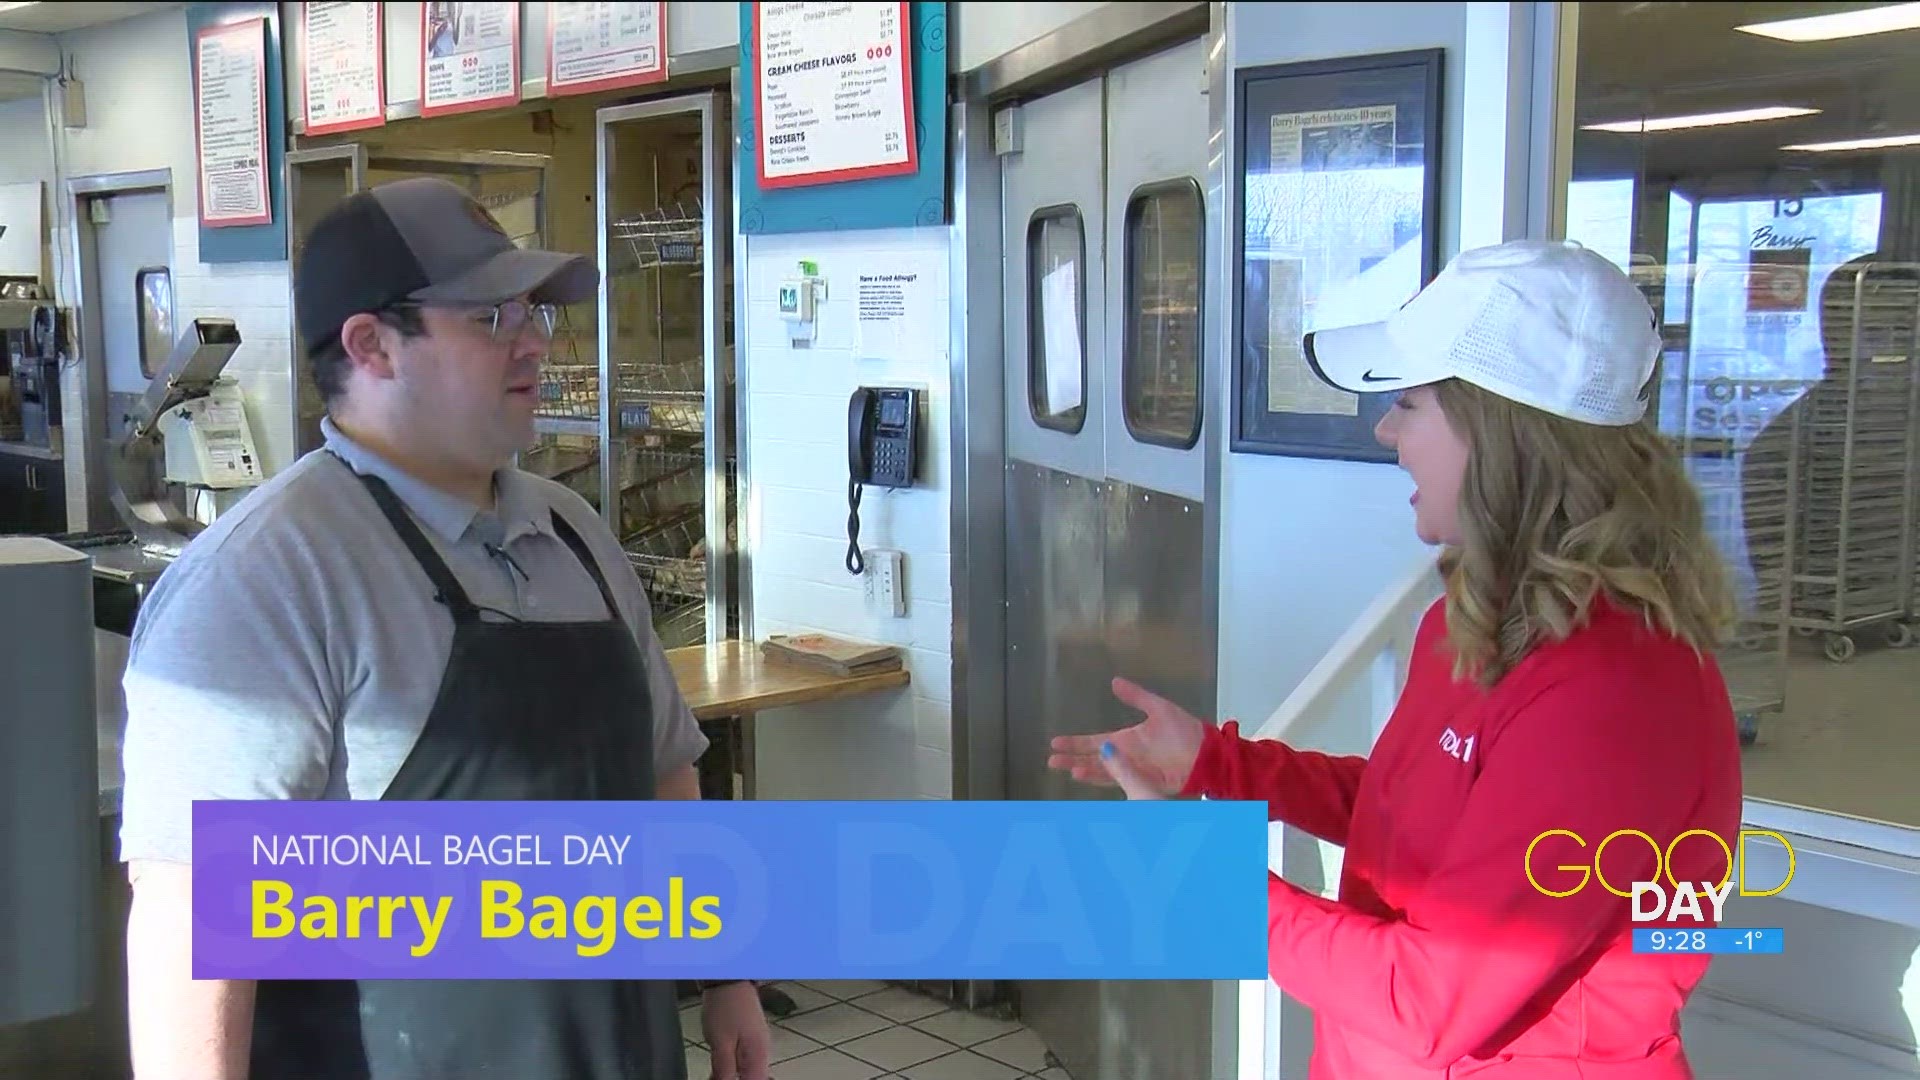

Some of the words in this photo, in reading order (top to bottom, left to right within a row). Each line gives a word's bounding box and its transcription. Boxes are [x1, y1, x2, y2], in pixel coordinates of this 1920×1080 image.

[767, 63, 792, 77] CREAM
[793, 59, 820, 73] CHEESE
[822, 52, 857, 67] FLAVORS
[1370, 109, 1392, 120] years
[769, 131, 806, 145] DESSERTS
[621, 411, 649, 427] PLAIN
